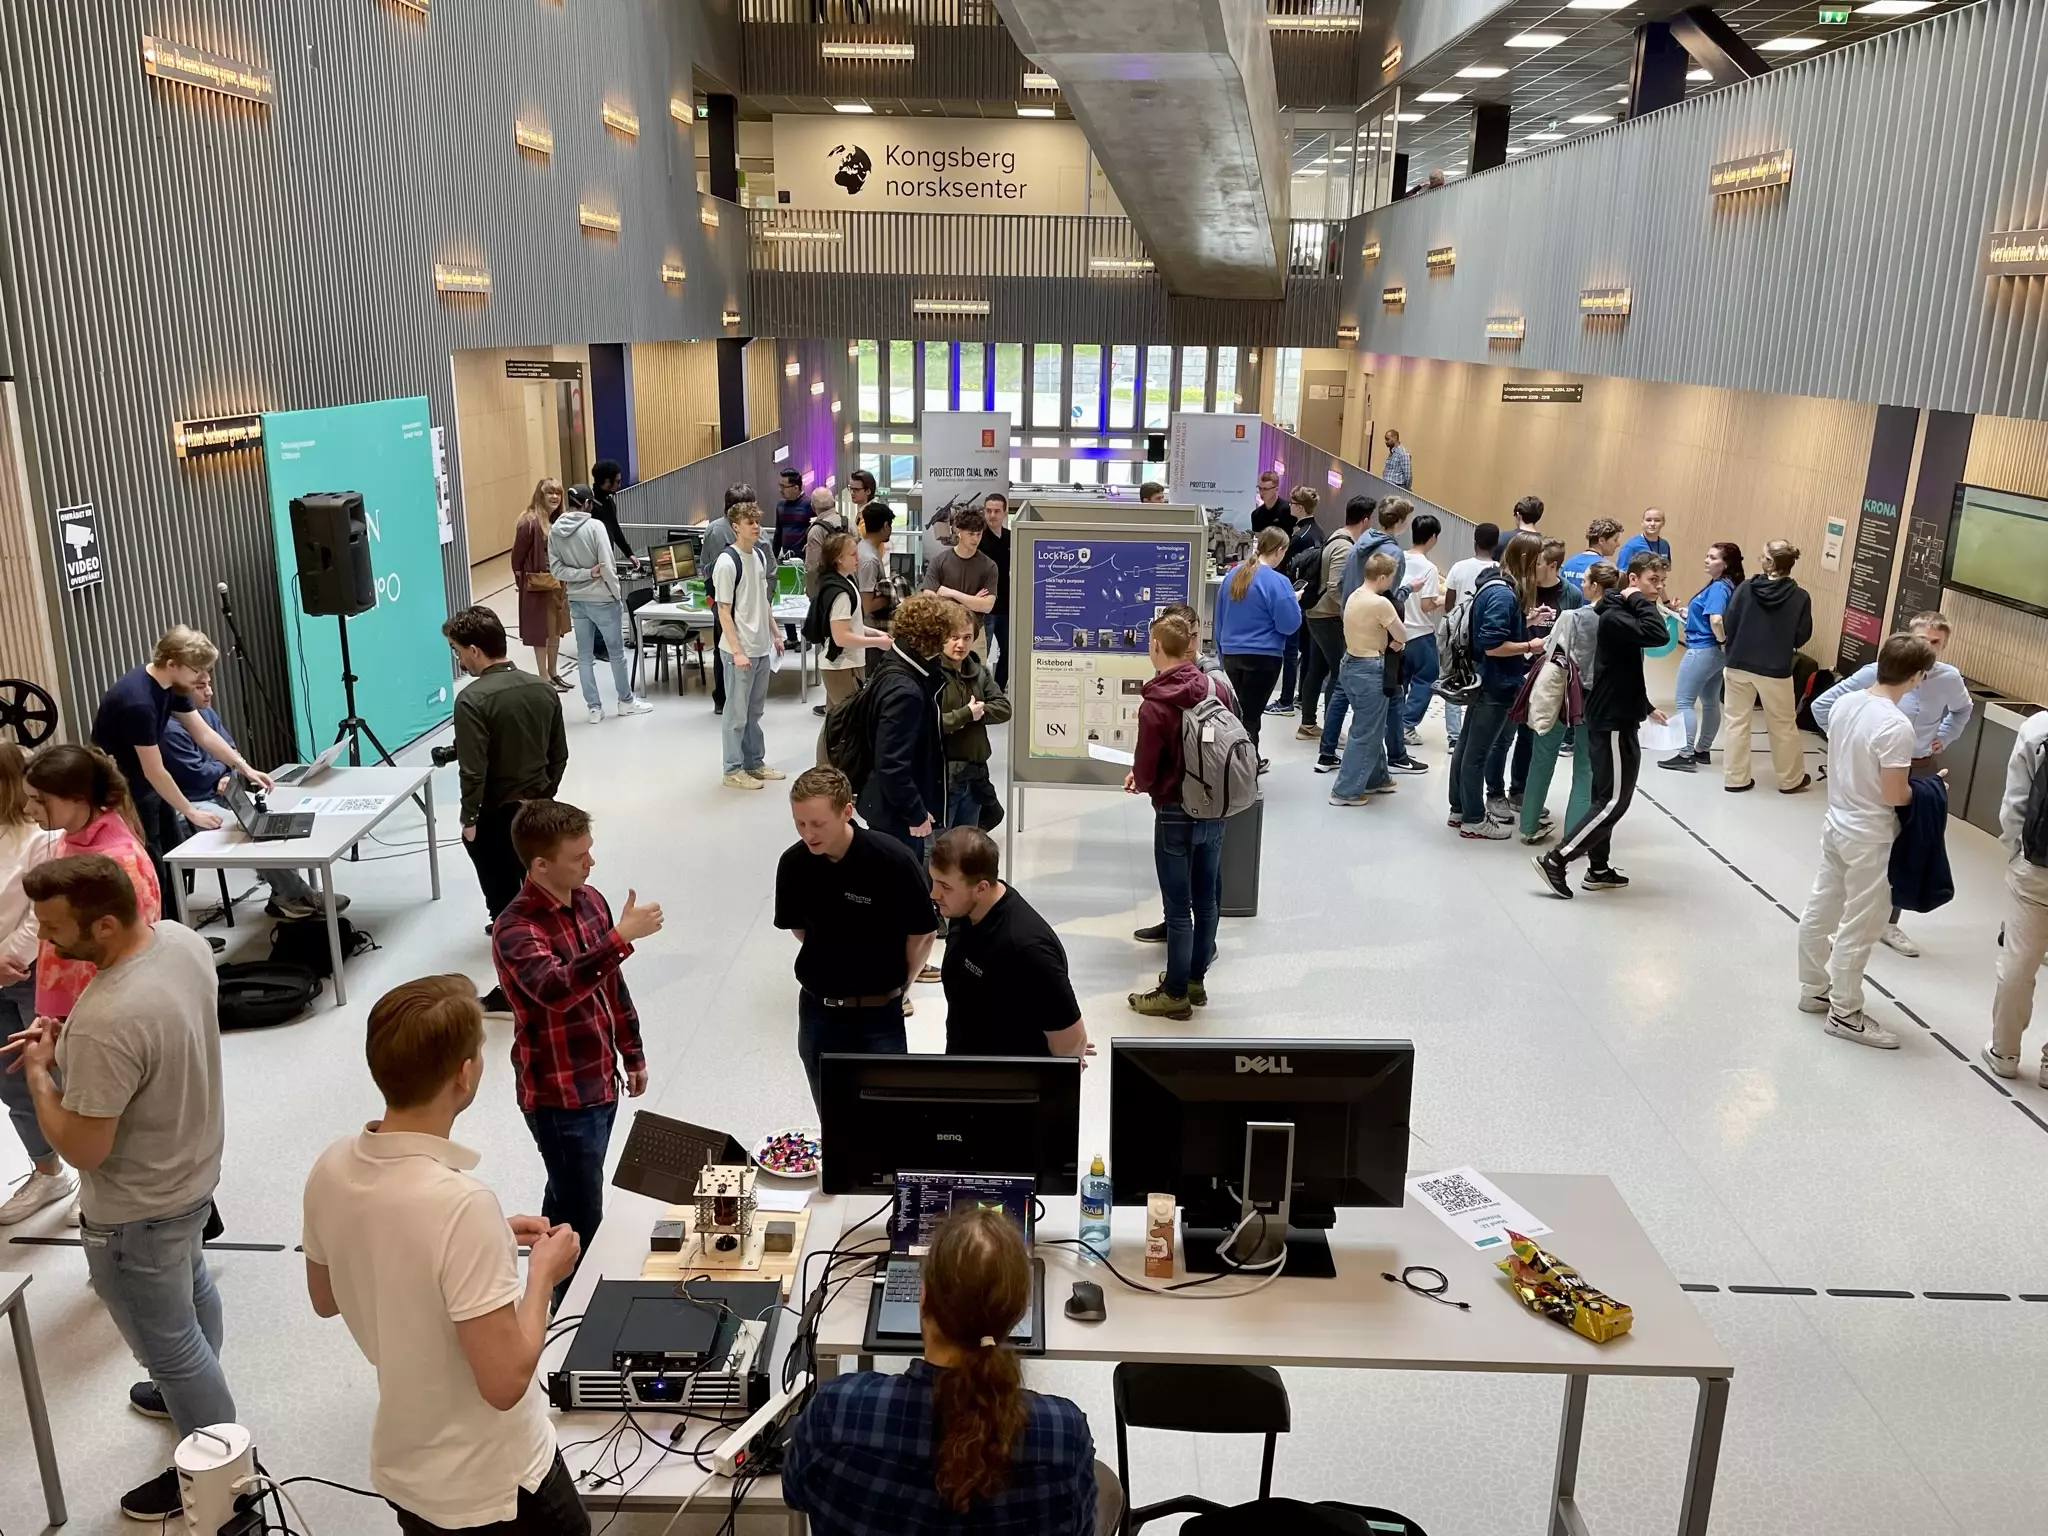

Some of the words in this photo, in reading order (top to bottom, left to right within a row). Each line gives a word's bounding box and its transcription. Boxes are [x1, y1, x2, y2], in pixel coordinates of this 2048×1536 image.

[886, 144, 1015, 174] Kongsberg
[886, 176, 1028, 198] norsksenter
[930, 468, 965, 477] PROTECTOR
[967, 468, 982, 477] DUAL
[984, 468, 998, 477] RWS
[60, 510, 85, 521] OMRÅDET
[1864, 499, 1896, 518] KRONA
[1038, 551, 1074, 561] LockTap
[67, 556, 99, 576] VIDEO
[1036, 658, 1073, 667] Ristebord
[1047, 723, 1067, 736] USN
[1235, 1056, 1293, 1074] DELL
